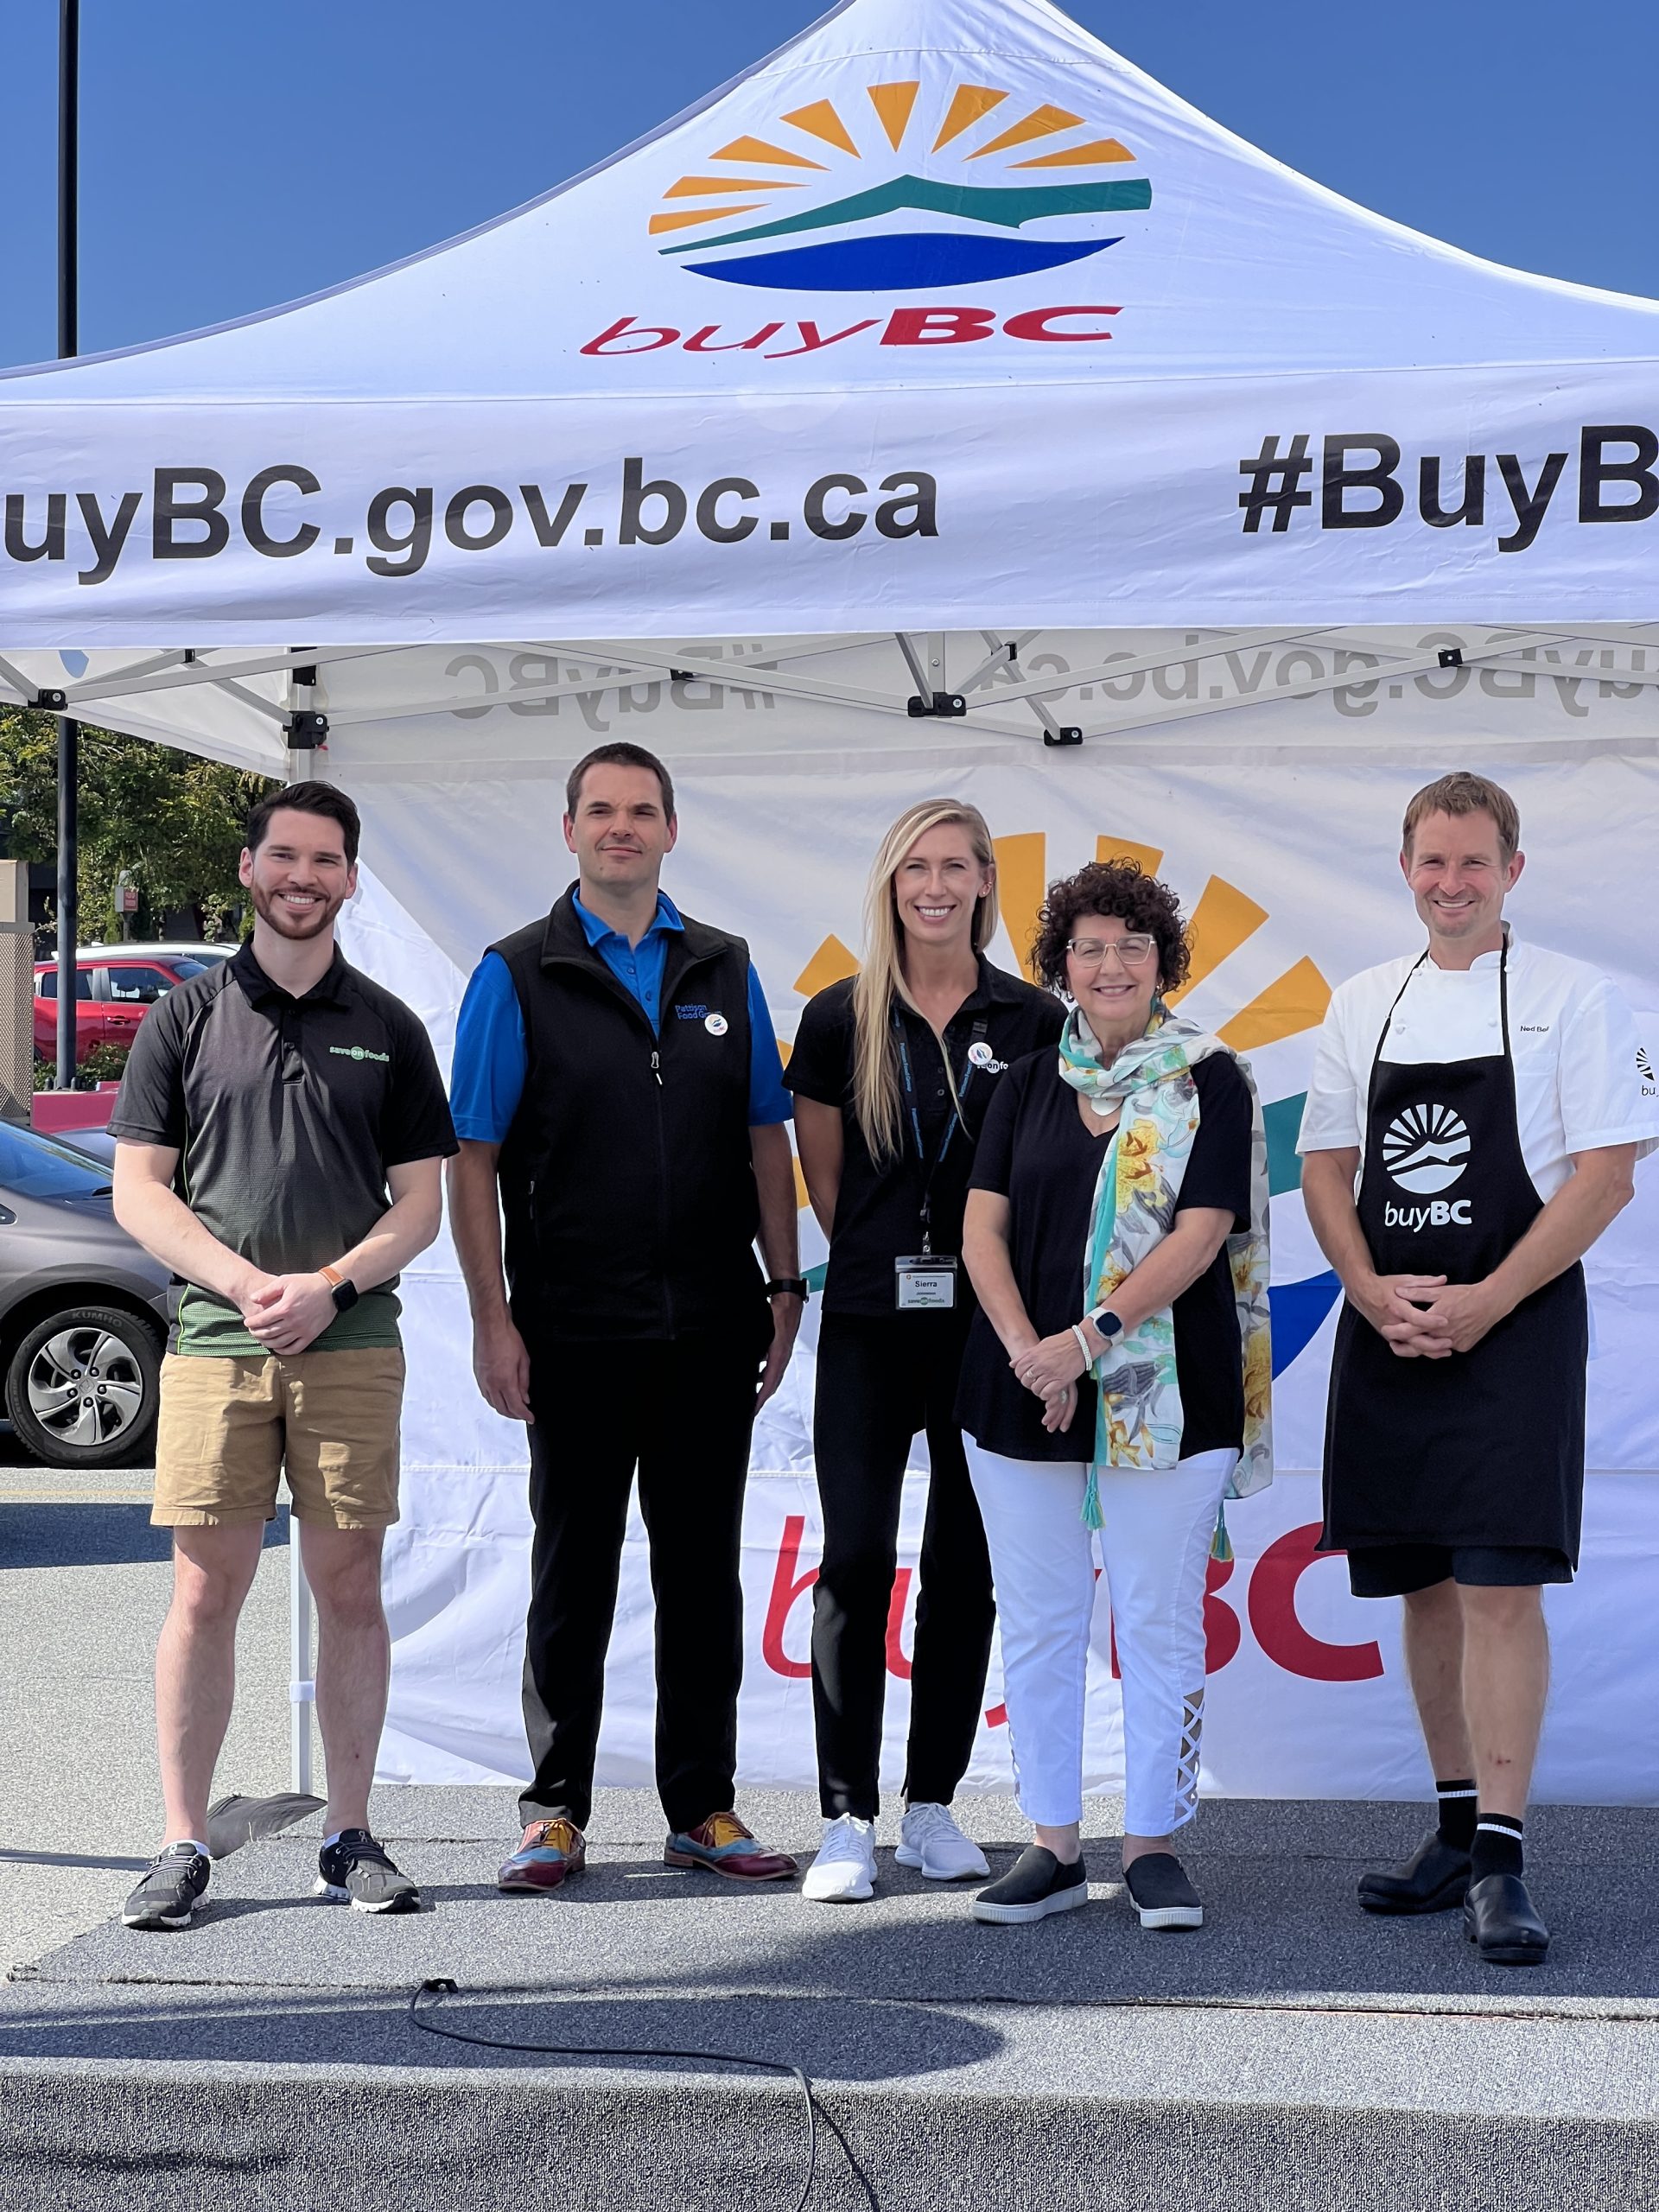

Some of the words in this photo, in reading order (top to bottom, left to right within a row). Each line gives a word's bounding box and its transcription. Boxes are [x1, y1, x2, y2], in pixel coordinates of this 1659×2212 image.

[580, 306, 1123, 359] buyBC
[1238, 425, 1659, 552] #BuyB
[675, 1004, 708, 1013] Pattison
[1642, 1085, 1659, 1097] bu
[1384, 1199, 1472, 1233] buyBC
[72, 1312, 122, 1327] KUMHO
